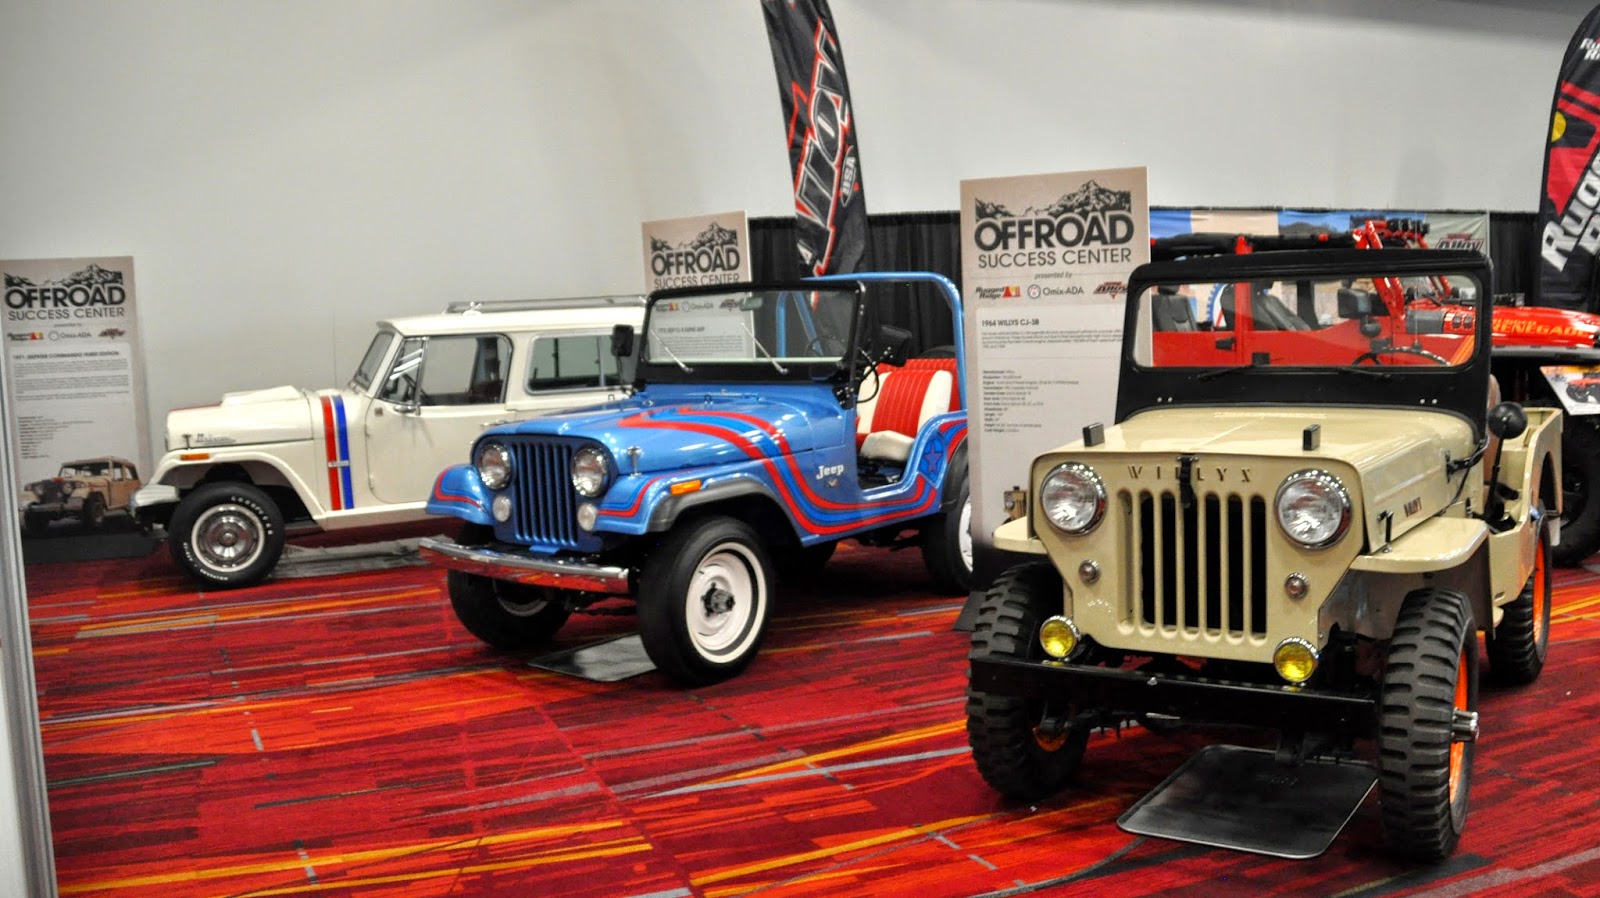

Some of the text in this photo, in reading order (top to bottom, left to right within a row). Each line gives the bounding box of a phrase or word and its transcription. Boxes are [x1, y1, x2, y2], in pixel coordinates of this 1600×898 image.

[842, 156, 857, 196] USA
[974, 213, 1134, 251] OFFROAD
[651, 247, 740, 276] OFFROAD
[978, 247, 1132, 269] SUCCESS CENTER
[654, 272, 740, 289] SUCCESS CENTER
[1042, 286, 1085, 296] Omix-ADA
[5, 285, 126, 309] OFFROAD
[8, 306, 125, 321] SUCCESS CENTER
[816, 464, 844, 480] Jeep
